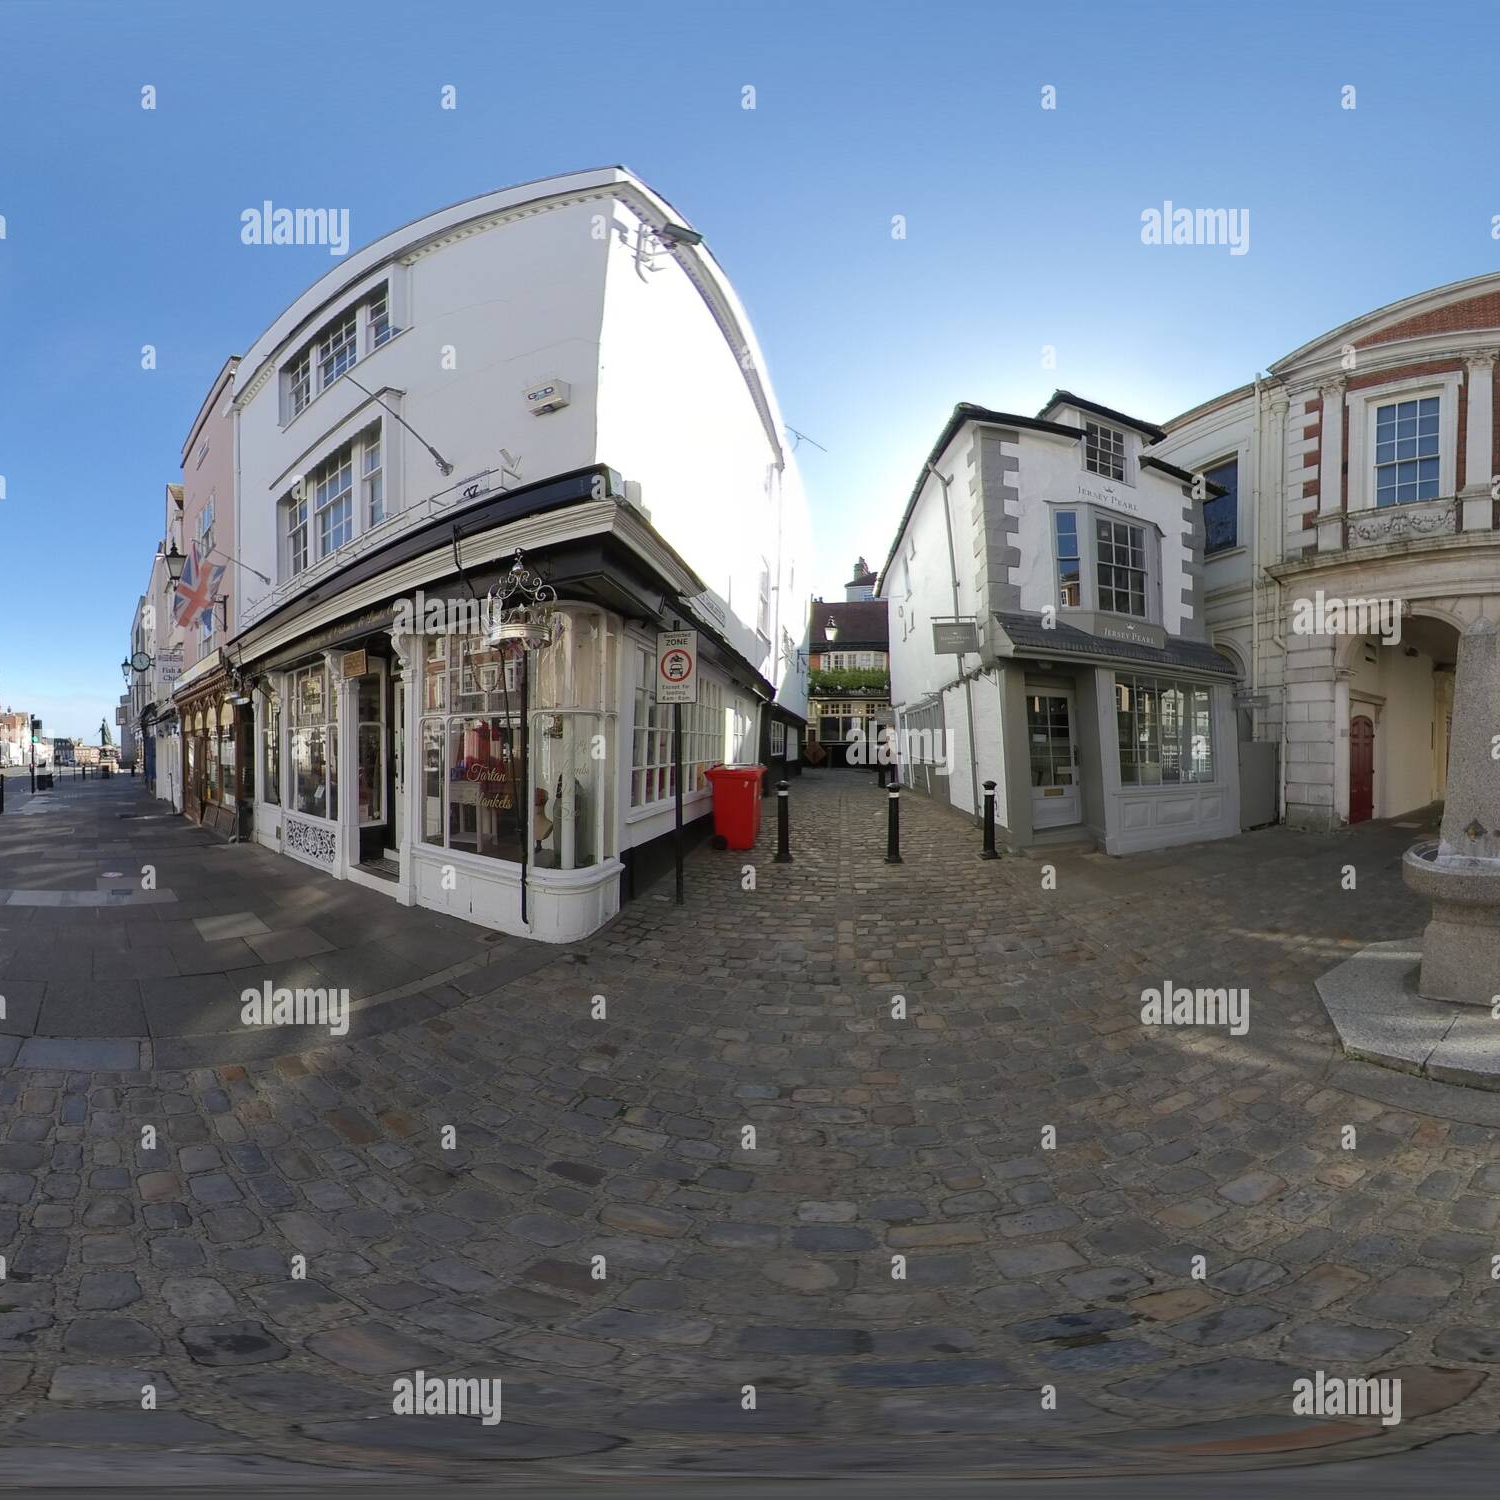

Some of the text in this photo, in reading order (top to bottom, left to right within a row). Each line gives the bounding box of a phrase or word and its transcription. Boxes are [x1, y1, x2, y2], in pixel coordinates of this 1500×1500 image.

[1077, 485, 1138, 511] JERSEY PEARL
[666, 638, 688, 646] ZONE
[1104, 627, 1155, 645] JERSEY PEARL
[467, 763, 506, 783] Tartan
